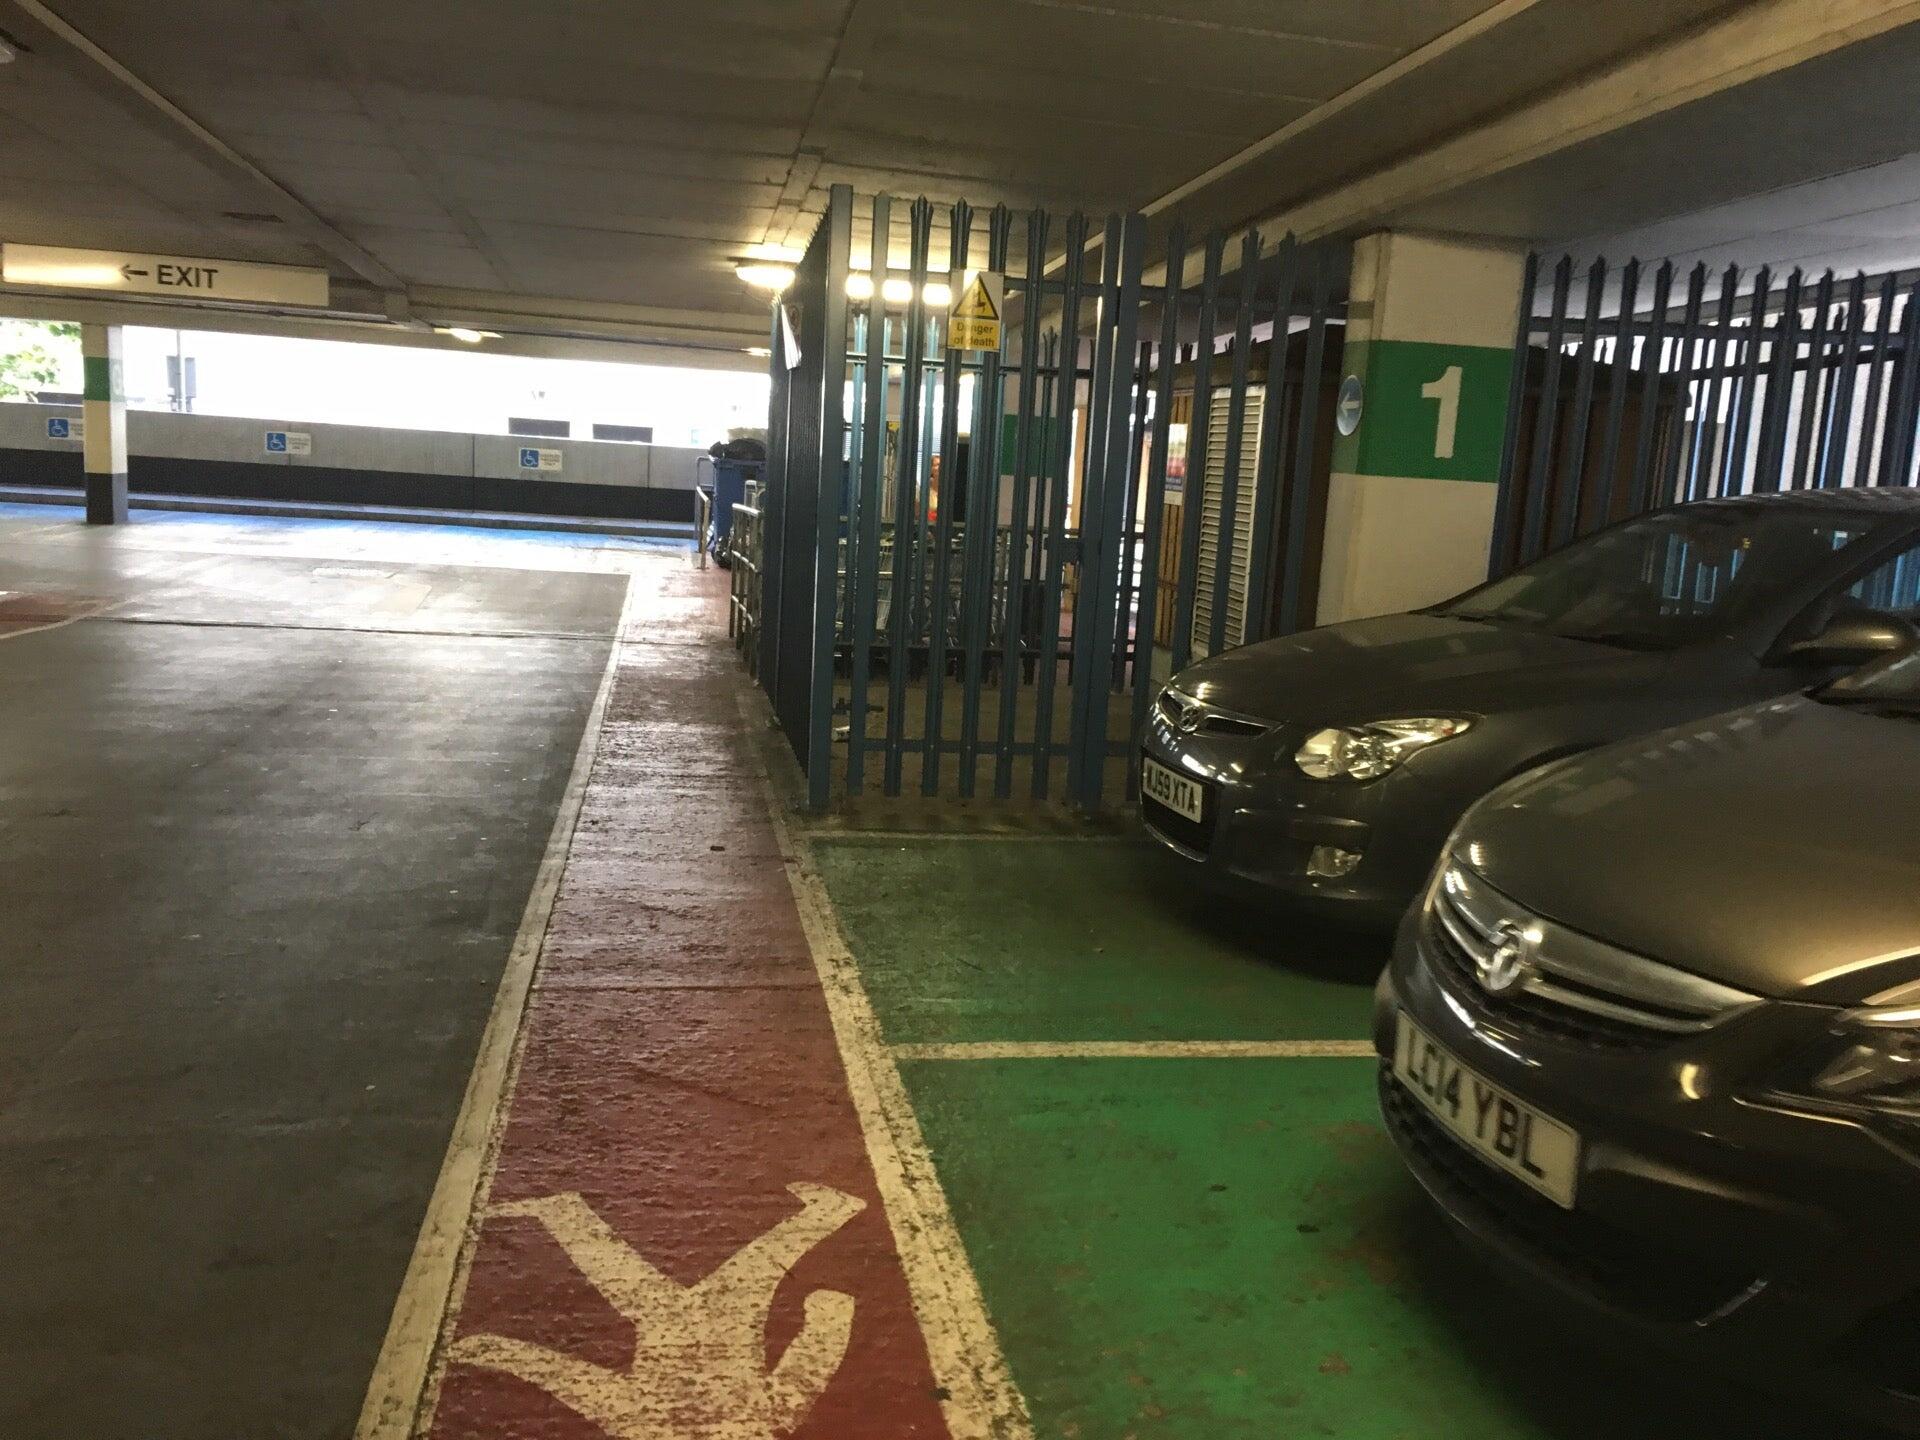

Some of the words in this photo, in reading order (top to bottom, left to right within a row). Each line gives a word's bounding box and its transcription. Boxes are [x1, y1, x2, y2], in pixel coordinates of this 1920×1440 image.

[157, 264, 219, 289] EXIT
[953, 335, 964, 345] of
[956, 322, 994, 335] Dnger
[1422, 365, 1463, 459] 1
[1172, 777, 1196, 815] XTA
[1473, 1080, 1546, 1181] YBL
